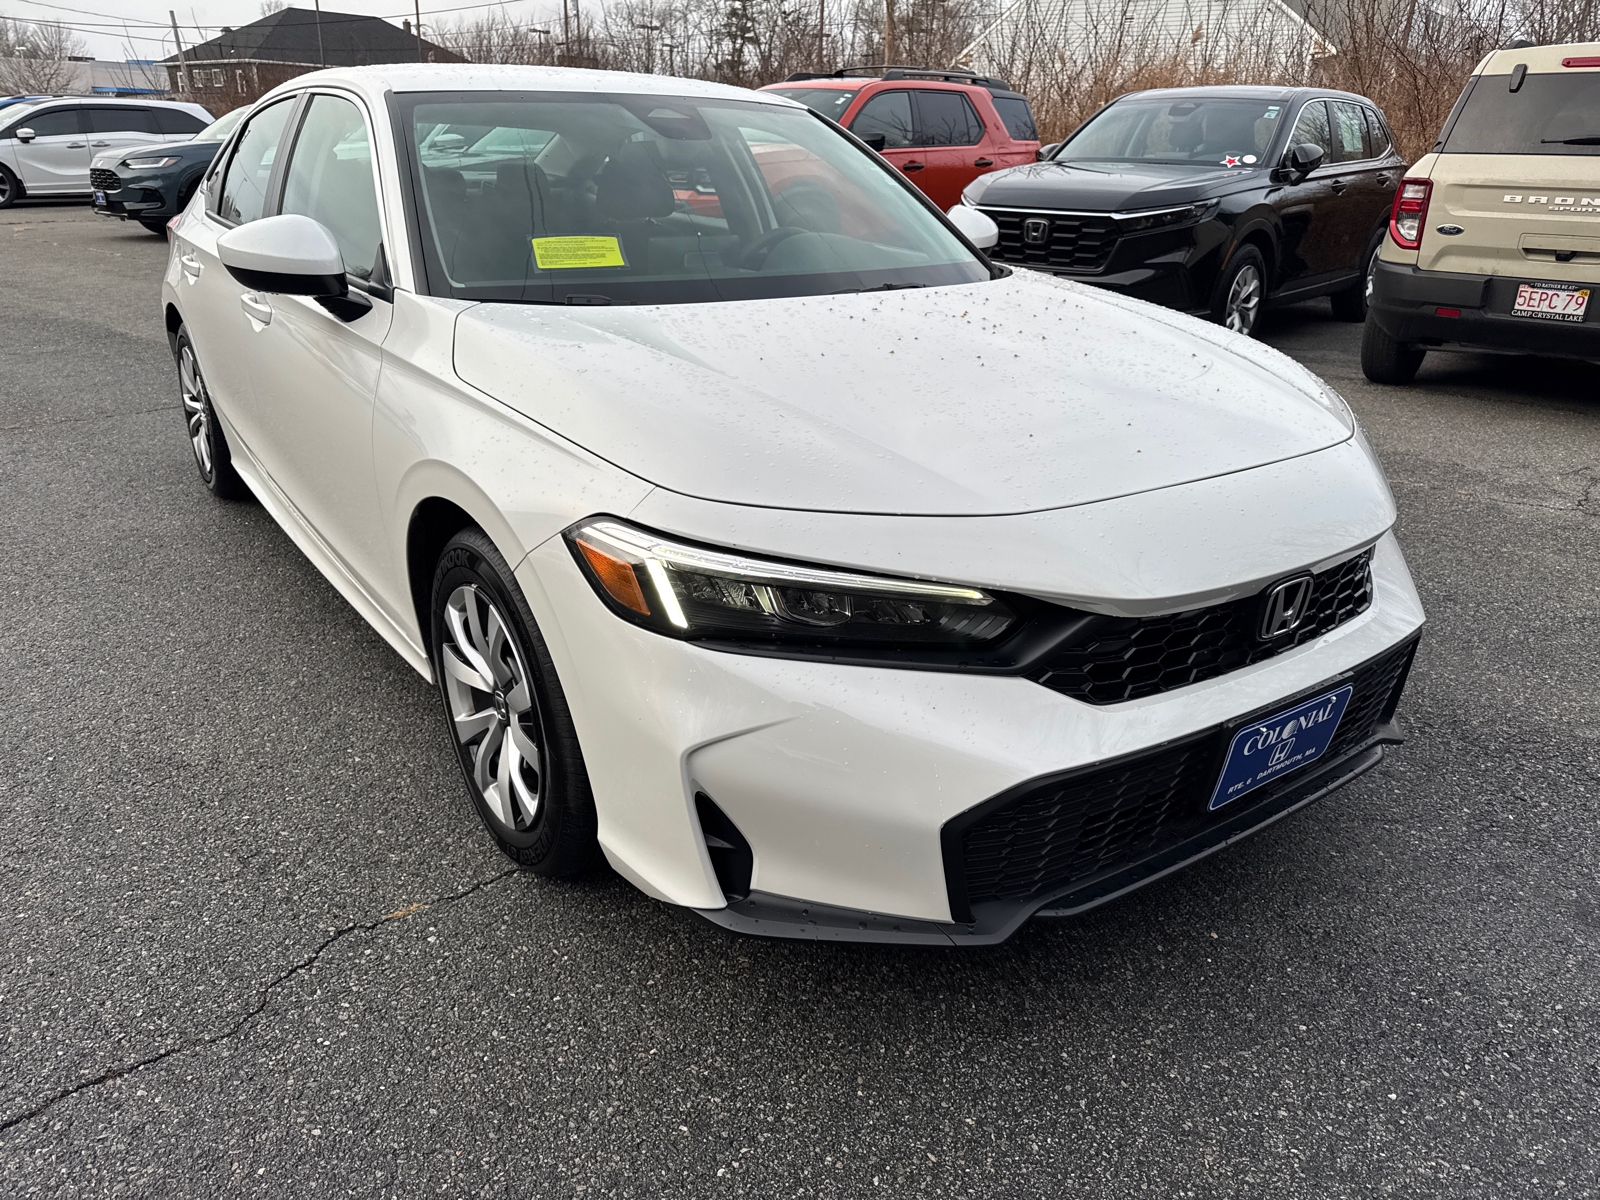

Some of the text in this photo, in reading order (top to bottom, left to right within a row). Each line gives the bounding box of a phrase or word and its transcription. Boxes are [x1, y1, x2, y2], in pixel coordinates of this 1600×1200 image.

[1517, 290, 1585, 312] 5EPC 79
[1511, 309, 1584, 322] CAMP CRYSTAL LAKE
[1243, 703, 1335, 756] COLONIAL
[1304, 747, 1316, 757] MA
